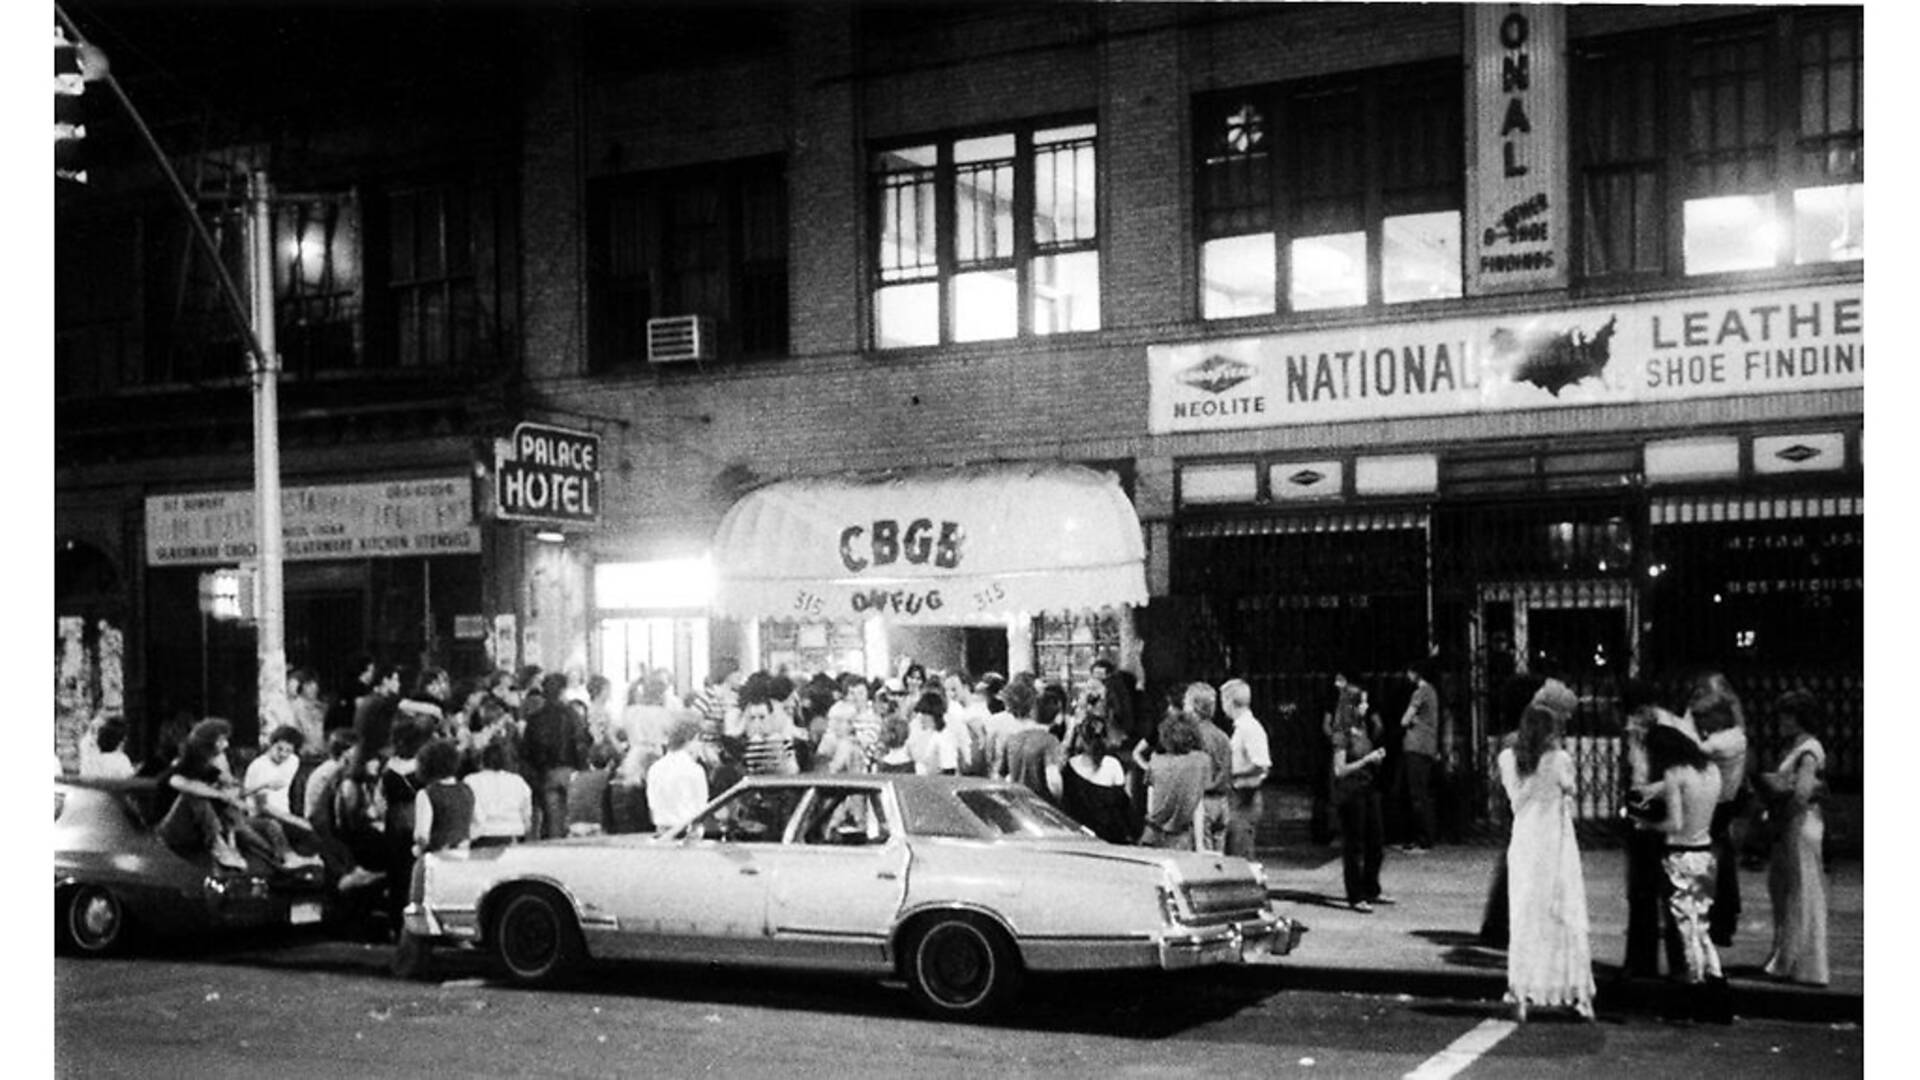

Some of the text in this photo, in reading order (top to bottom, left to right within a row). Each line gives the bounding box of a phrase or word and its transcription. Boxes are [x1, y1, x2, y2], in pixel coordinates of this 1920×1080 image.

[1500, 4, 1530, 178] ONAL
[1651, 299, 1862, 349] LEATHE
[1286, 341, 1480, 404] NATIONAL
[1646, 354, 1726, 388] SHOE
[1173, 396, 1266, 418] NEOLITE
[521, 434, 593, 471] PALACE
[506, 467, 593, 514] HOTEL
[839, 518, 966, 573] CBGB
